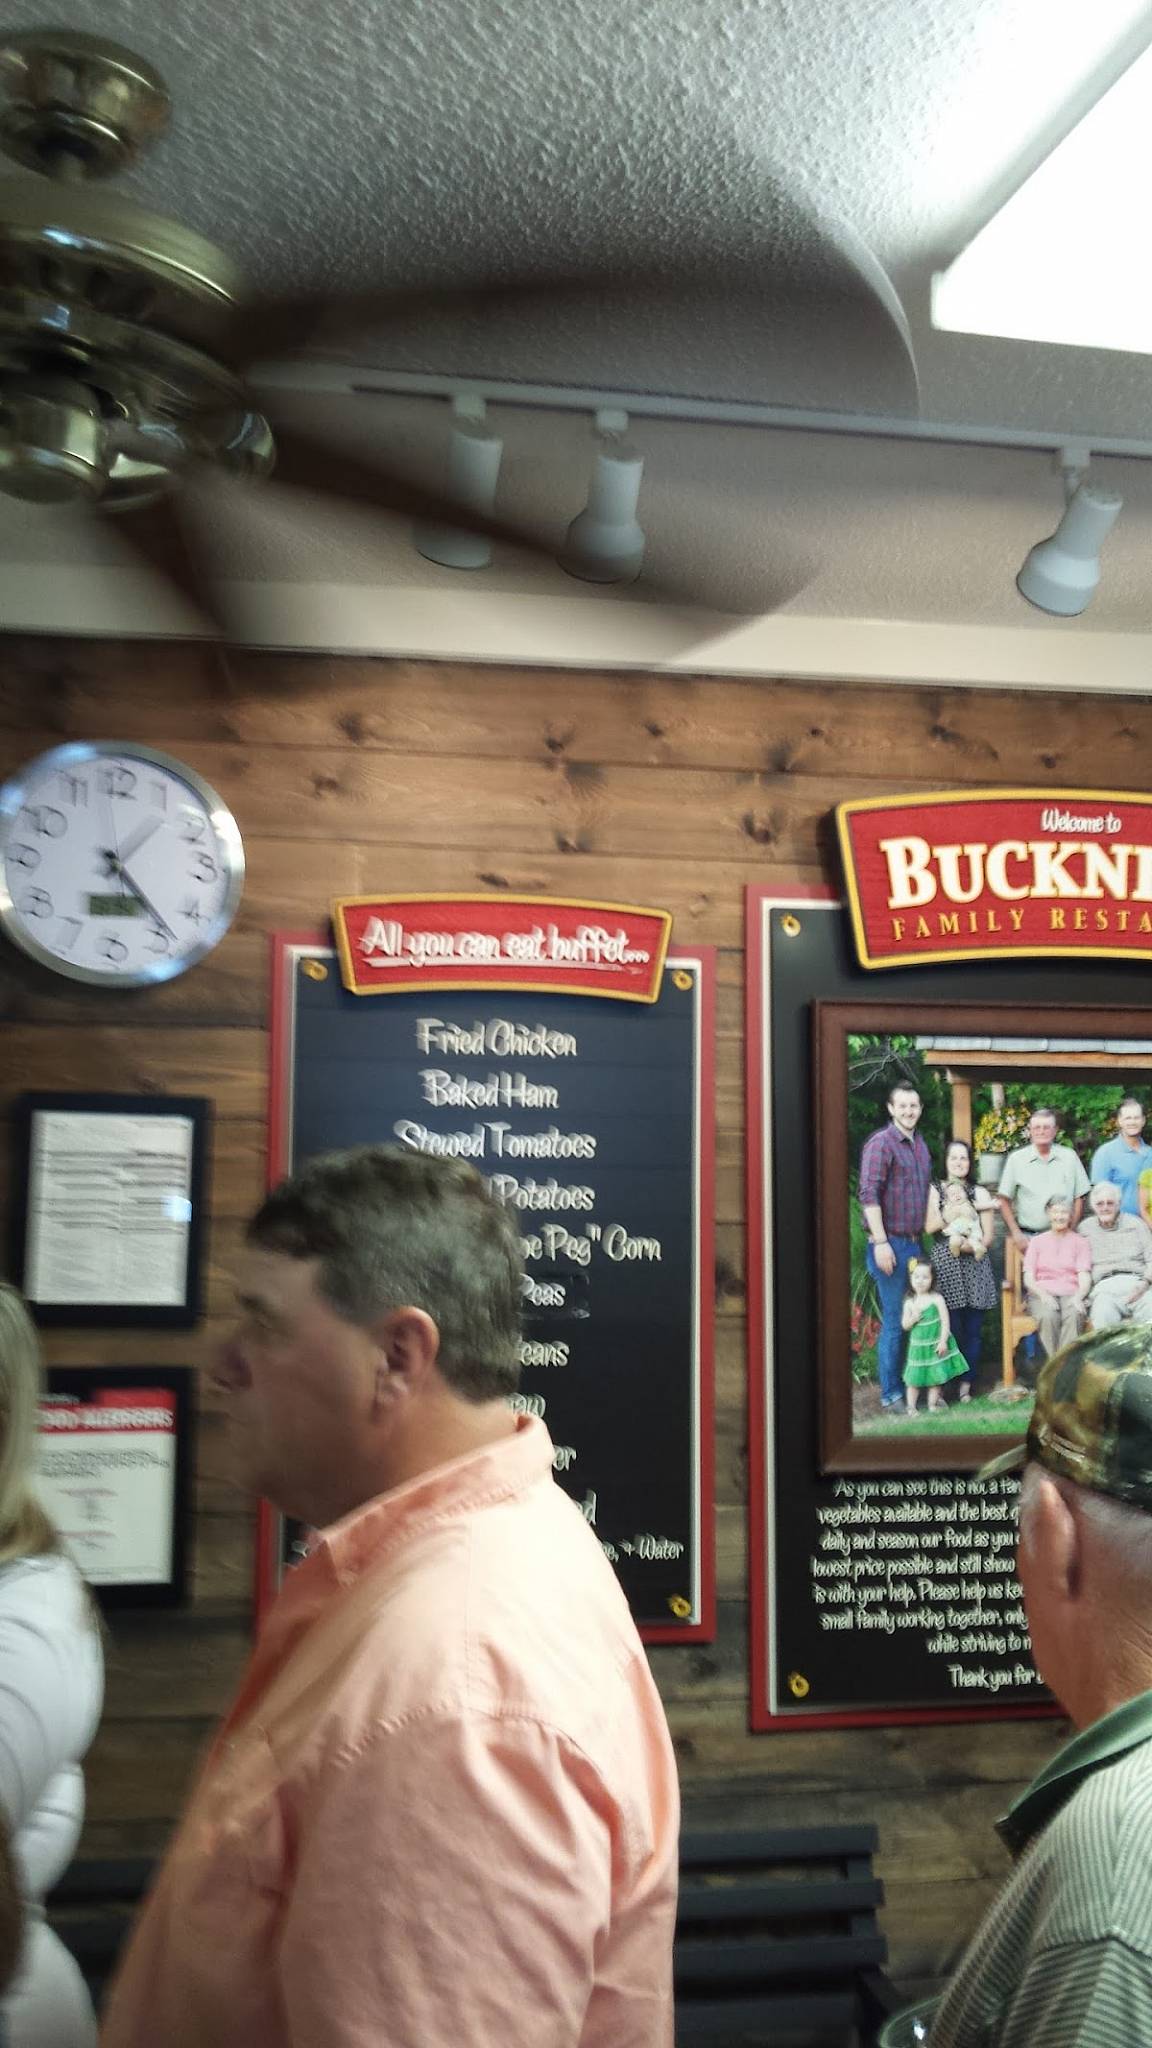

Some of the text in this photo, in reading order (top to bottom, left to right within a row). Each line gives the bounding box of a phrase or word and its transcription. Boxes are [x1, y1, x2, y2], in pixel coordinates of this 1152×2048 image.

[1040, 808, 1123, 834] Welcome to
[891, 907, 1025, 941] FAMILY
[357, 916, 403, 957] All
[403, 931, 455, 967] you
[454, 931, 500, 960] can
[501, 924, 546, 960] eat
[415, 1018, 577, 1059] Fried Chicken
[418, 1069, 559, 1110] Baked Ham
[393, 1119, 597, 1159] Stewed Tomatoes
[488, 1173, 596, 1211] Potatoes
[602, 1223, 662, 1261] Corn
[519, 1340, 570, 1367] eans
[834, 1479, 855, 1498] As
[857, 1482, 880, 1503] you
[881, 1481, 904, 1497] can
[905, 1481, 928, 1497] see
[816, 1501, 881, 1527] vegetables
[883, 1501, 933, 1522] available
[934, 1500, 958, 1521] and
[959, 1500, 980, 1521] the
[981, 1499, 1009, 1521] best
[635, 1532, 684, 1560] Water
[820, 1528, 851, 1556] daily
[852, 1528, 876, 1549] and
[877, 1532, 920, 1549] season
[921, 1532, 943, 1548] our
[944, 1526, 973, 1548] food
[974, 1531, 990, 1547] as
[991, 1531, 1014, 1553] you
[811, 1550, 1016, 1583] lowest price possible and still show
[812, 1582, 827, 1604] is
[828, 1581, 856, 1603] with
[857, 1586, 888, 1608] your
[917, 1577, 960, 1601] Please
[961, 1578, 987, 1608] help
[988, 1582, 1004, 1600] us
[820, 1607, 854, 1630] small
[855, 1607, 896, 1634] family
[897, 1606, 946, 1630] working
[927, 1631, 960, 1653] while
[961, 1630, 1006, 1655] striving
[1007, 1630, 1022, 1651] to
[947, 1664, 990, 1688] Thank
[990, 1670, 1013, 1692] you
[1014, 1662, 1035, 1685] for
